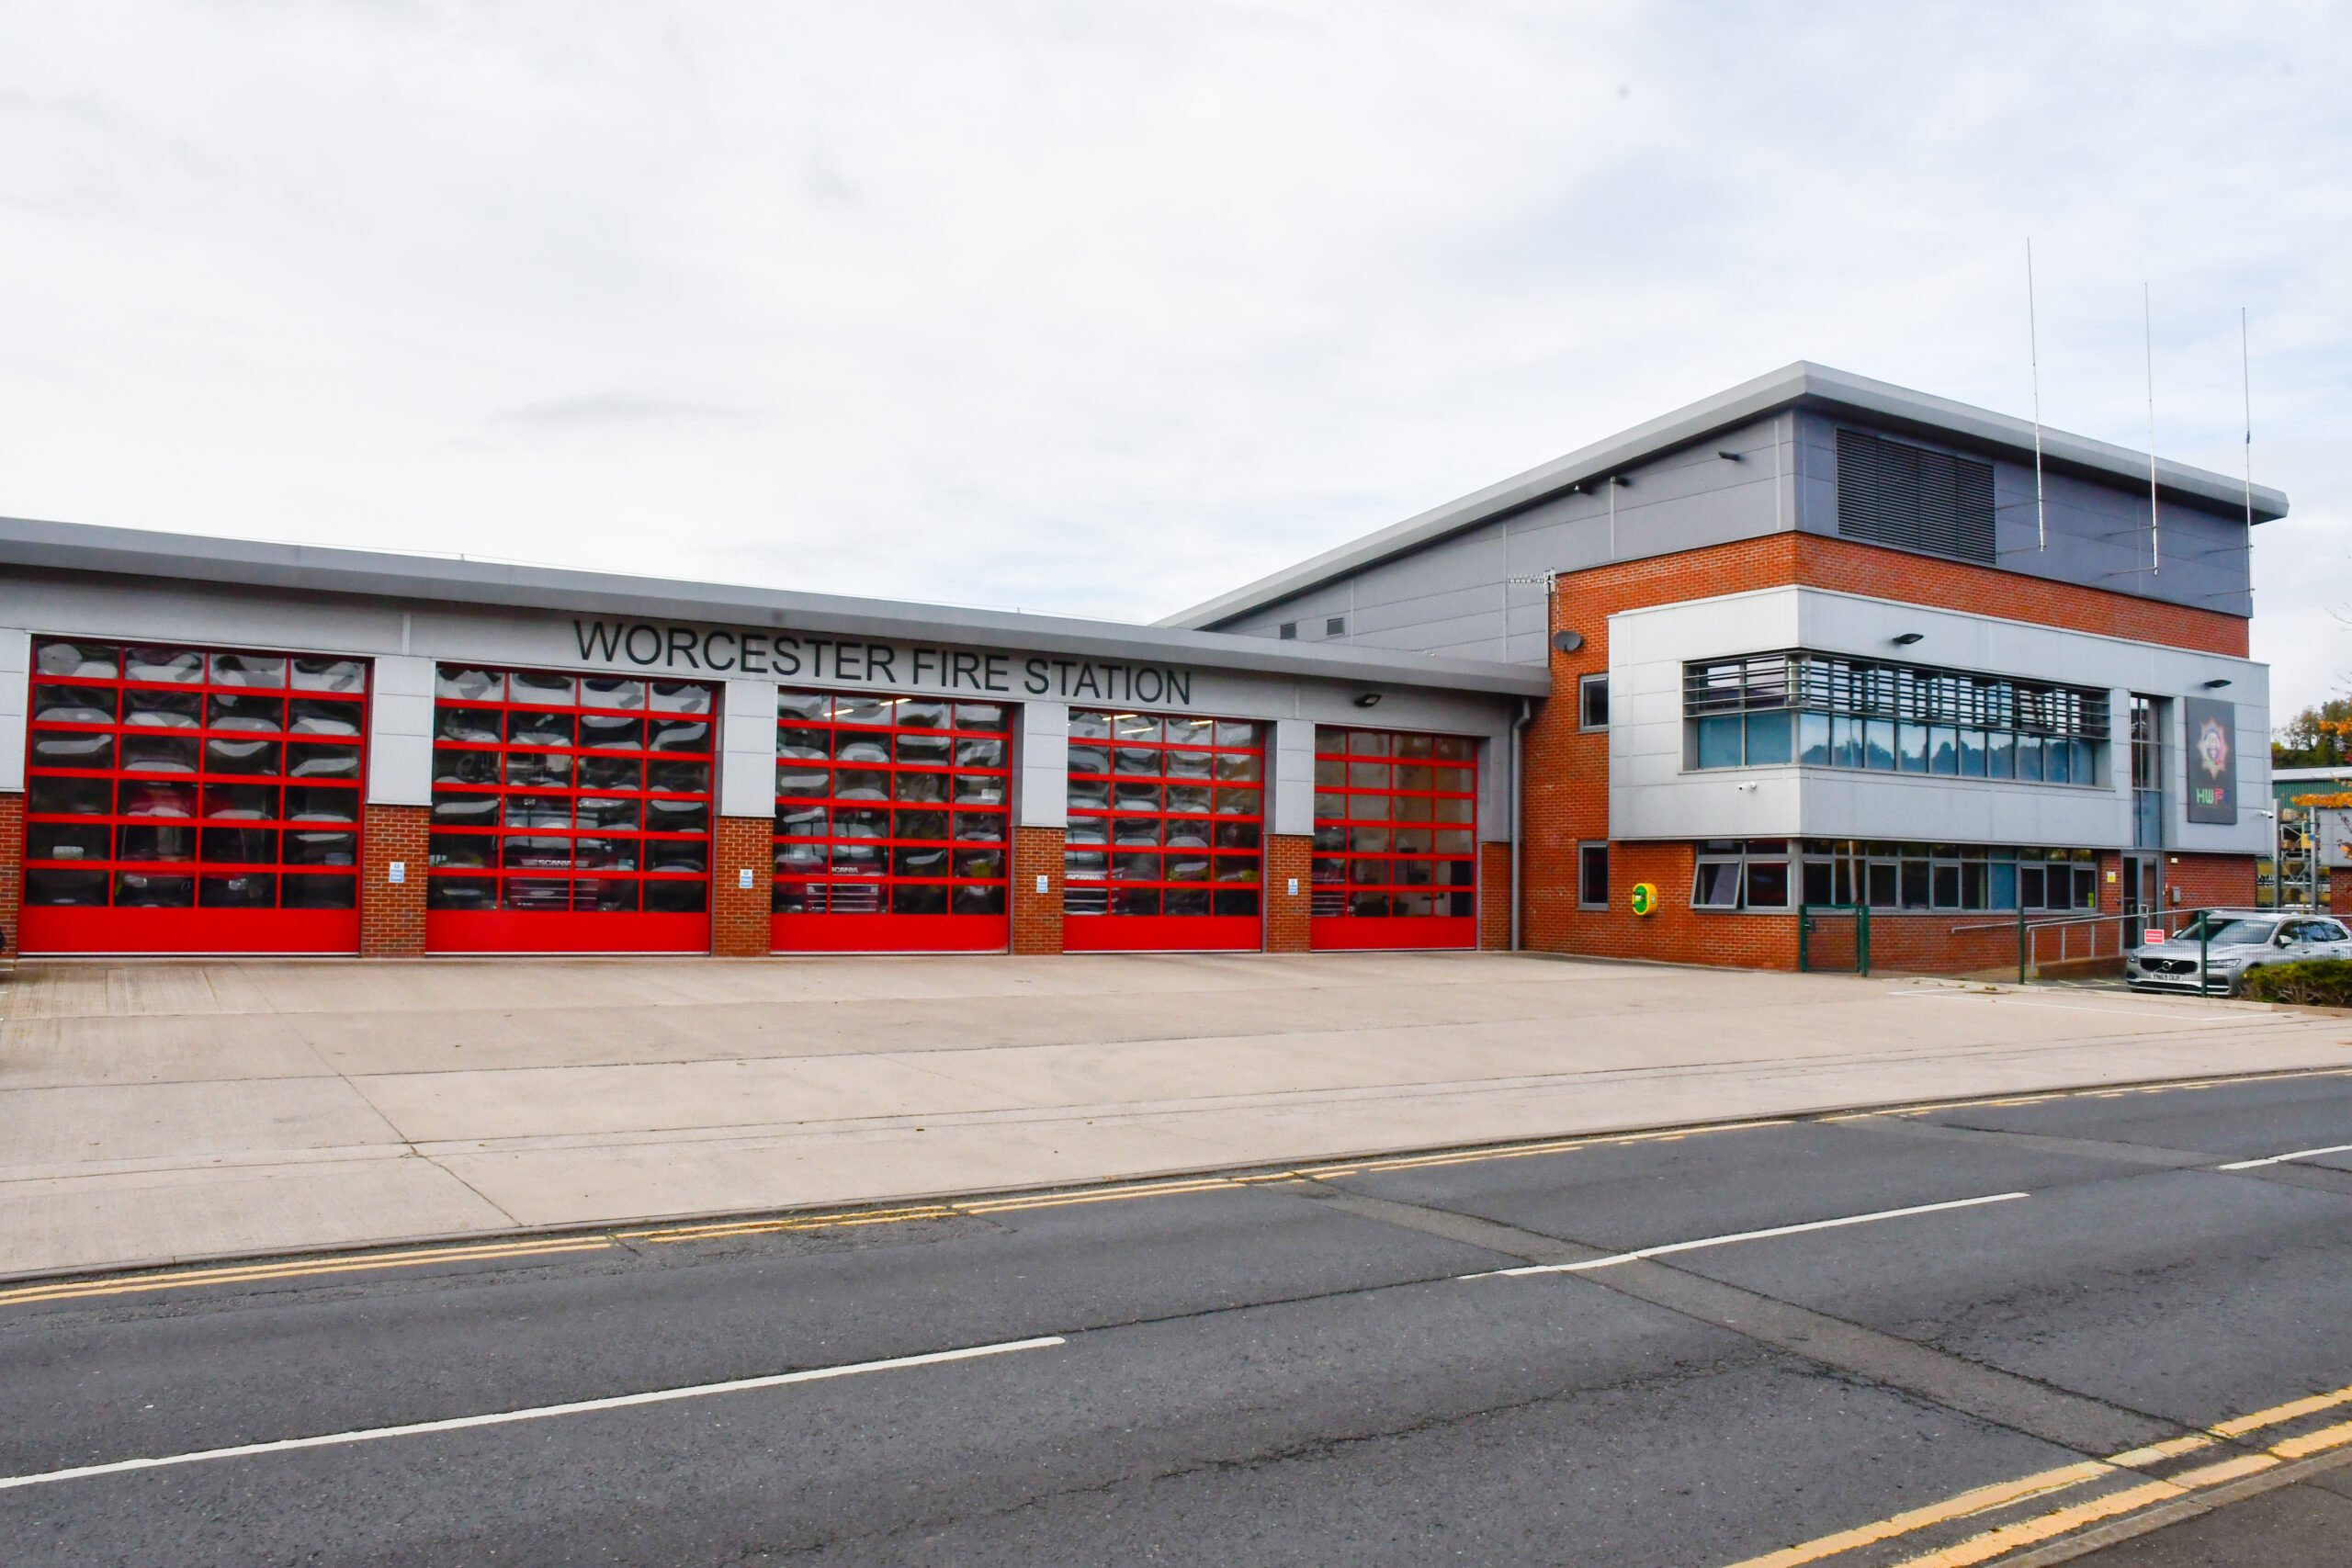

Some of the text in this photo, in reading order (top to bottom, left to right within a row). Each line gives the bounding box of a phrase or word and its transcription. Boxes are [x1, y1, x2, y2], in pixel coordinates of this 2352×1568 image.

[574, 619, 1190, 705] WORCESTER FIRE STATION
